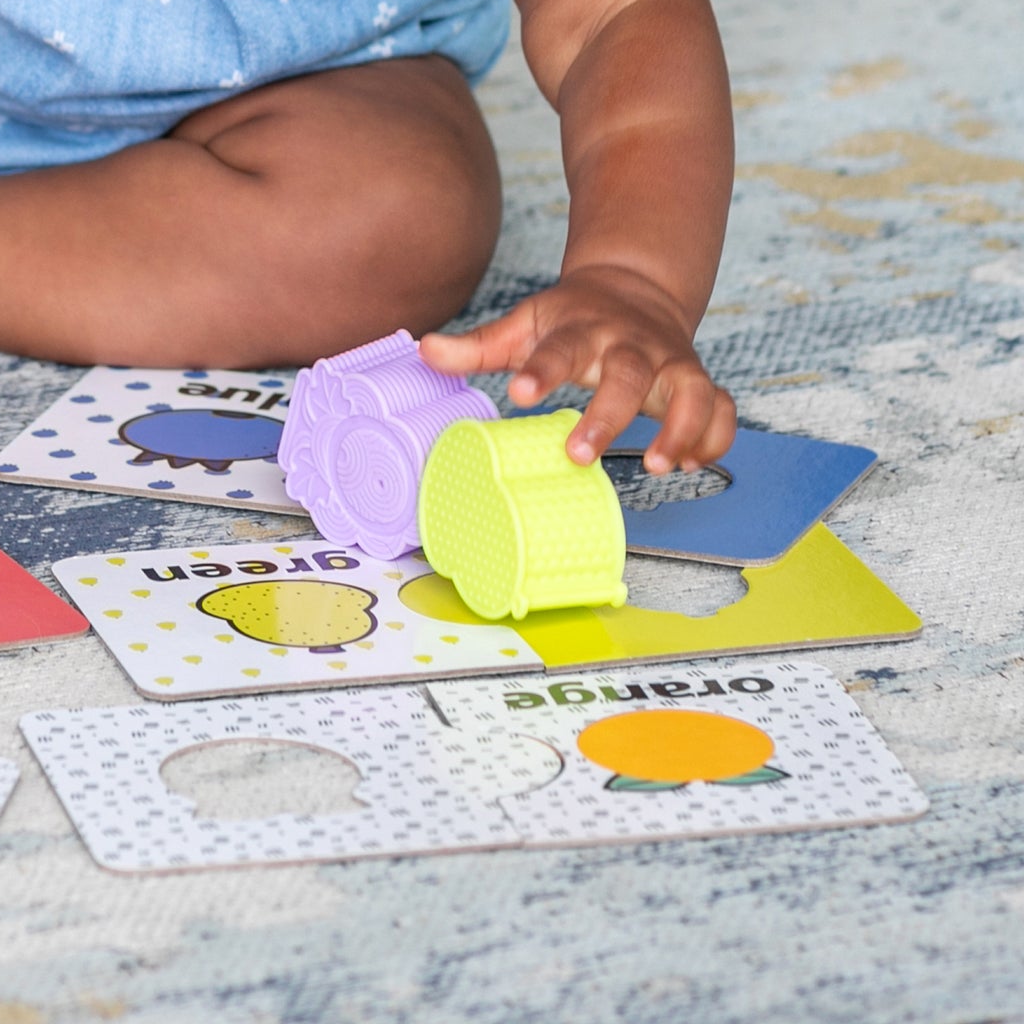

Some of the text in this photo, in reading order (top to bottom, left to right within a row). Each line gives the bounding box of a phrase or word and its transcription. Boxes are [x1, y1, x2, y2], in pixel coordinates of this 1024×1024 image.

[178, 382, 291, 410] lue
[141, 550, 361, 582] green
[502, 677, 774, 710] orange
